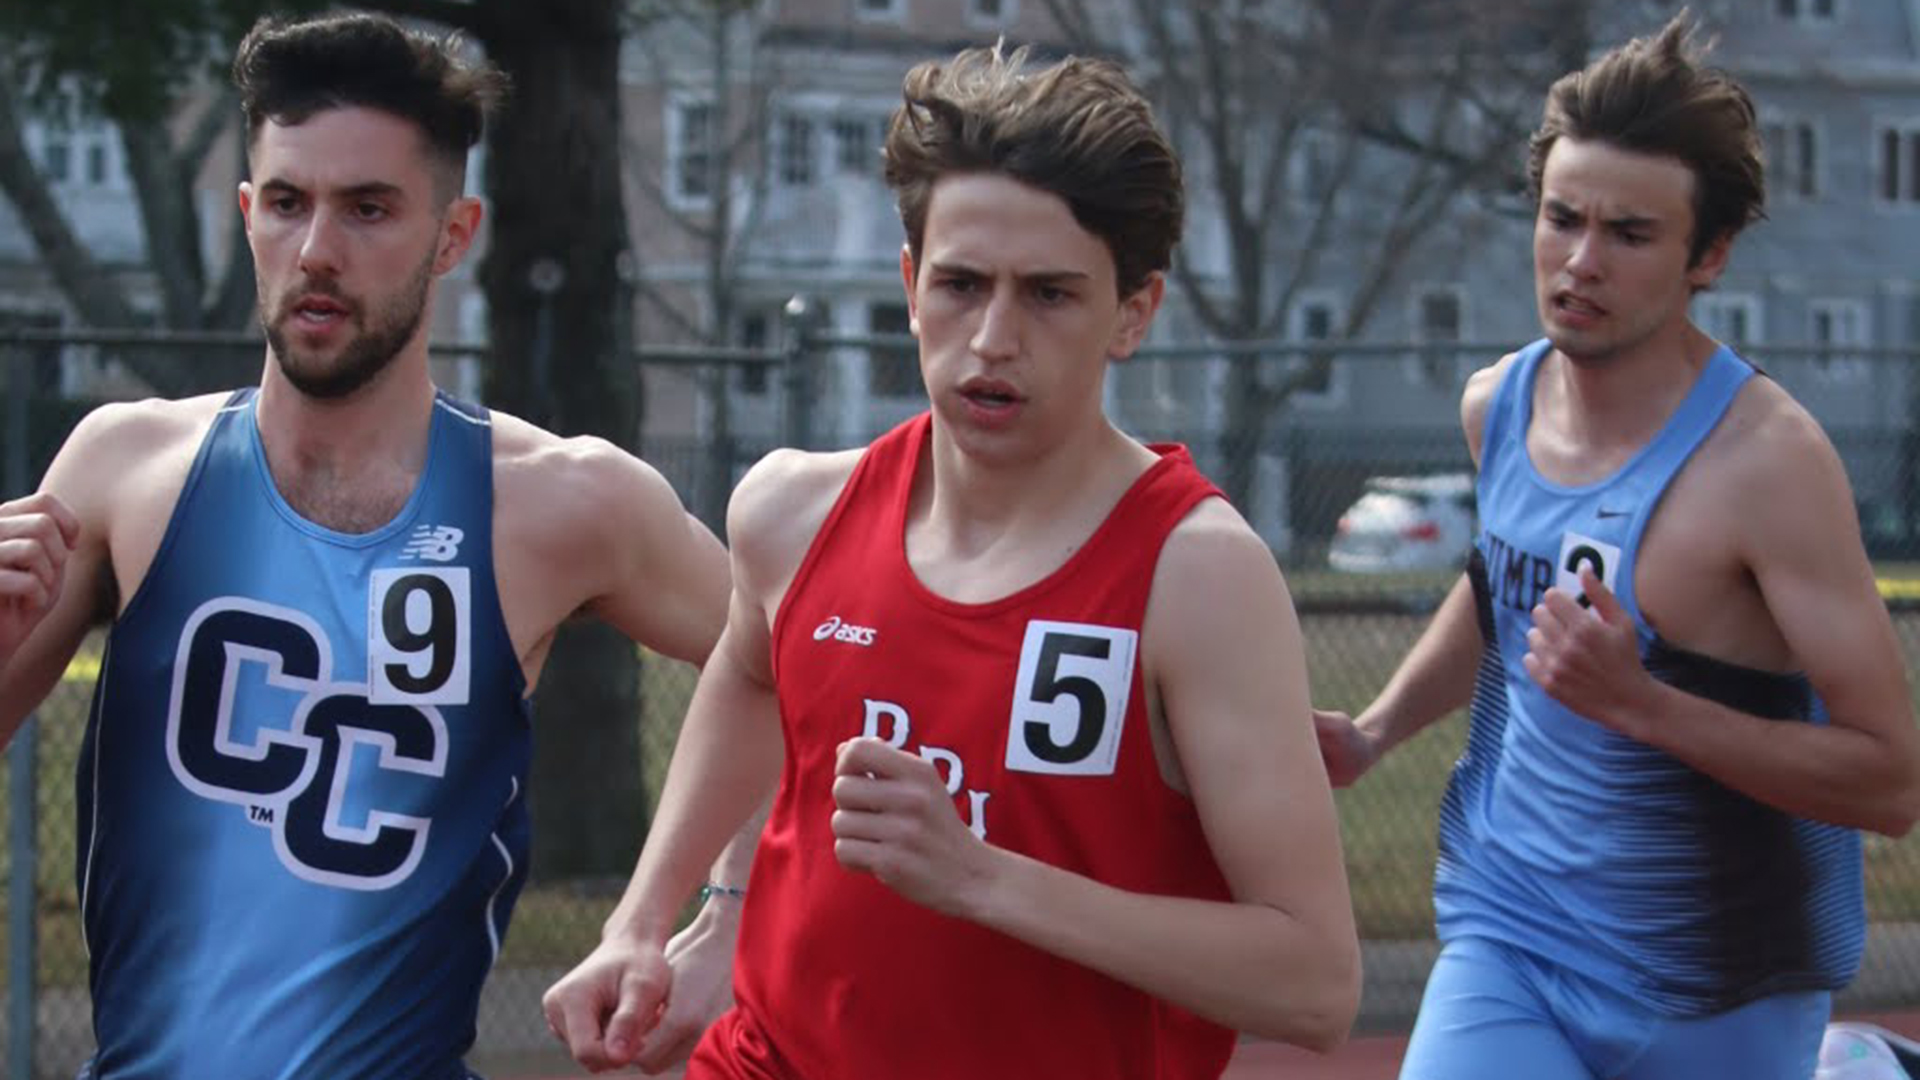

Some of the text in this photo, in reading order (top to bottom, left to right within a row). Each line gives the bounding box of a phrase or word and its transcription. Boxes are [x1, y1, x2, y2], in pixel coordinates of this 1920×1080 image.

[382, 573, 457, 694] 9
[166, 596, 449, 891] CC
[1023, 632, 1111, 764] 5
[250, 805, 274, 823] TM
